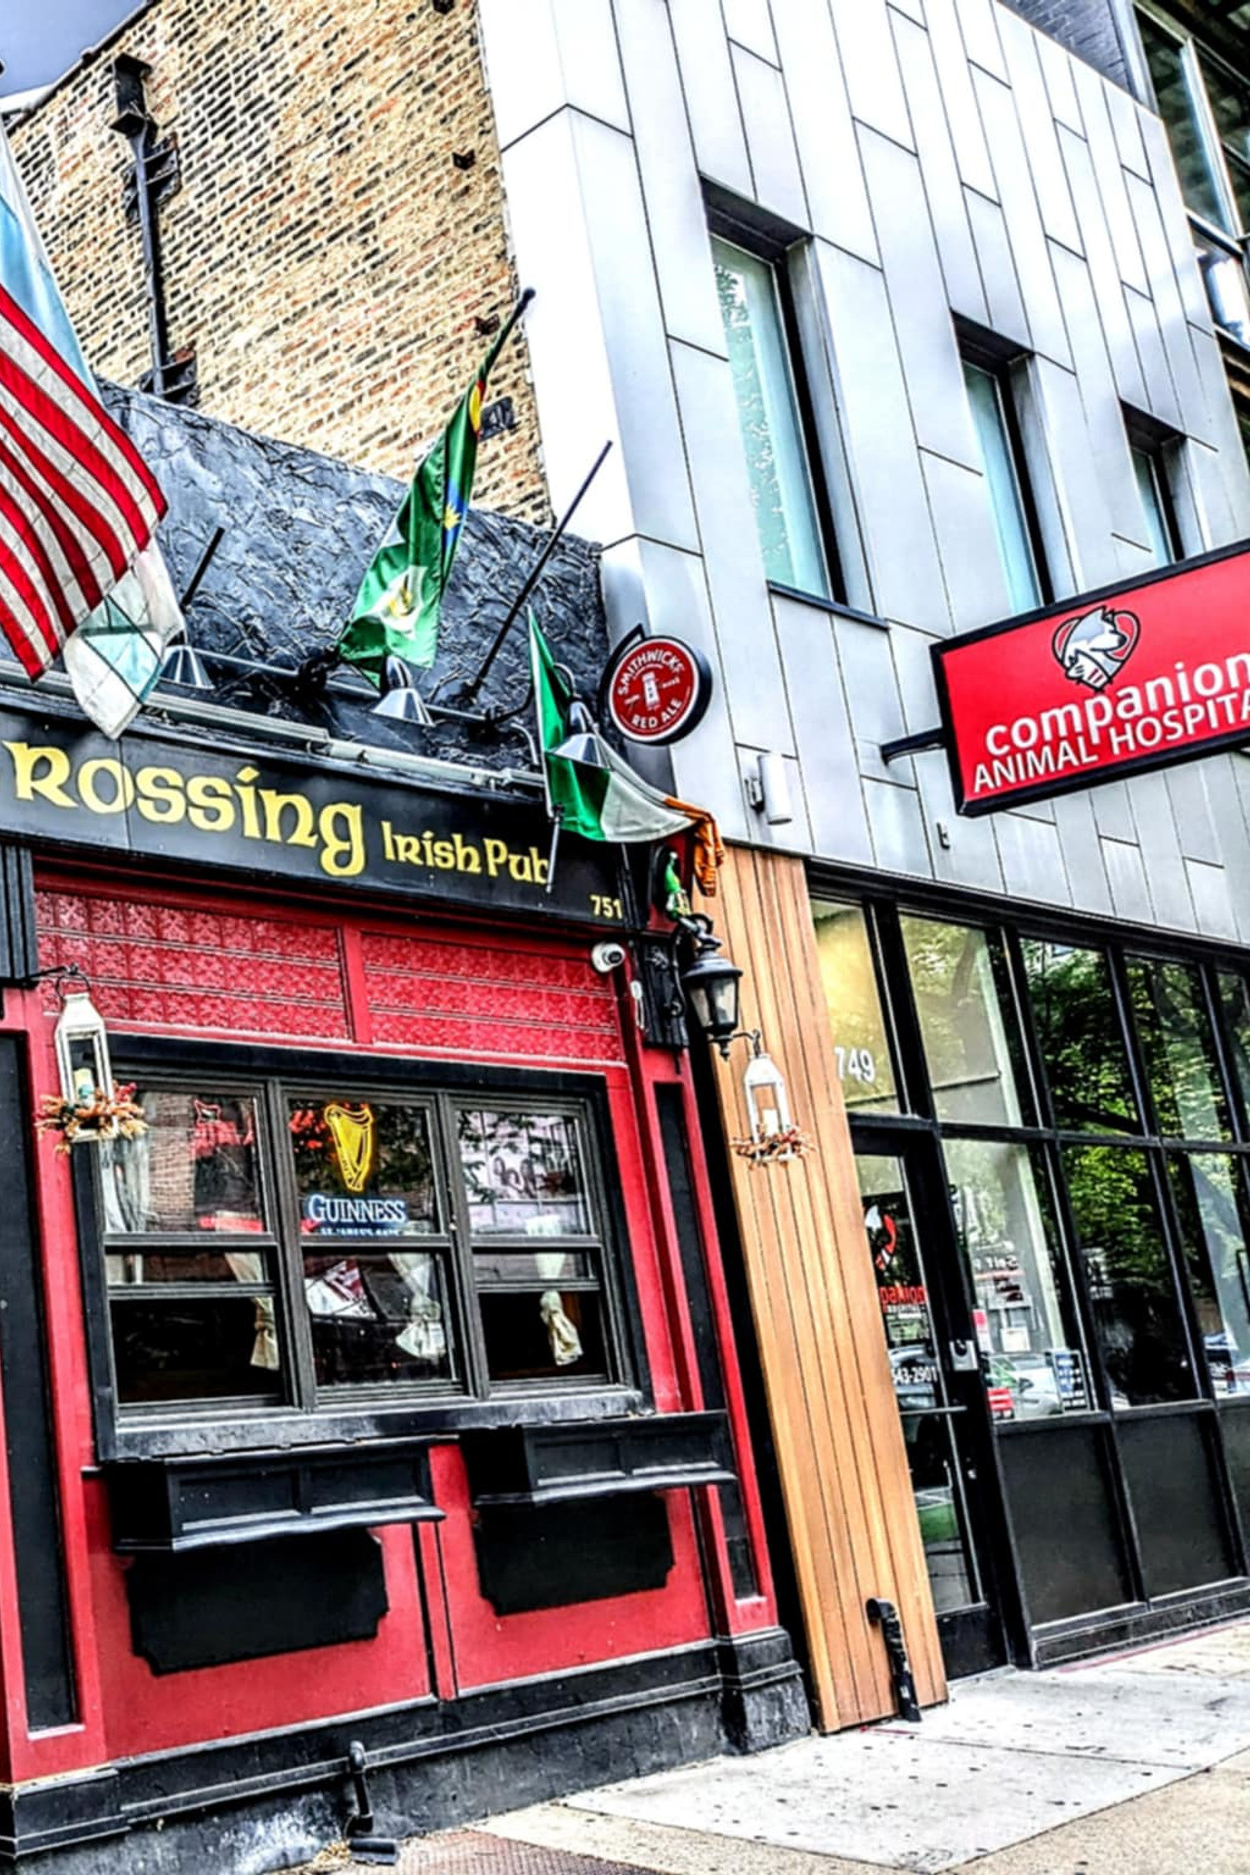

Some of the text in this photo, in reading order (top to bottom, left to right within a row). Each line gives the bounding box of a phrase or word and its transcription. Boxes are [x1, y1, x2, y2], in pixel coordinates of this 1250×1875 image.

[631, 713, 658, 729] RED
[661, 698, 683, 722] ALE
[985, 652, 1250, 756] companion
[973, 687, 1250, 793] ANIMAL HOSPITA
[381, 820, 549, 884] Irish Pub
[590, 894, 623, 920] 751
[834, 1046, 875, 1083] 749
[308, 1193, 407, 1223] GUINNESS
